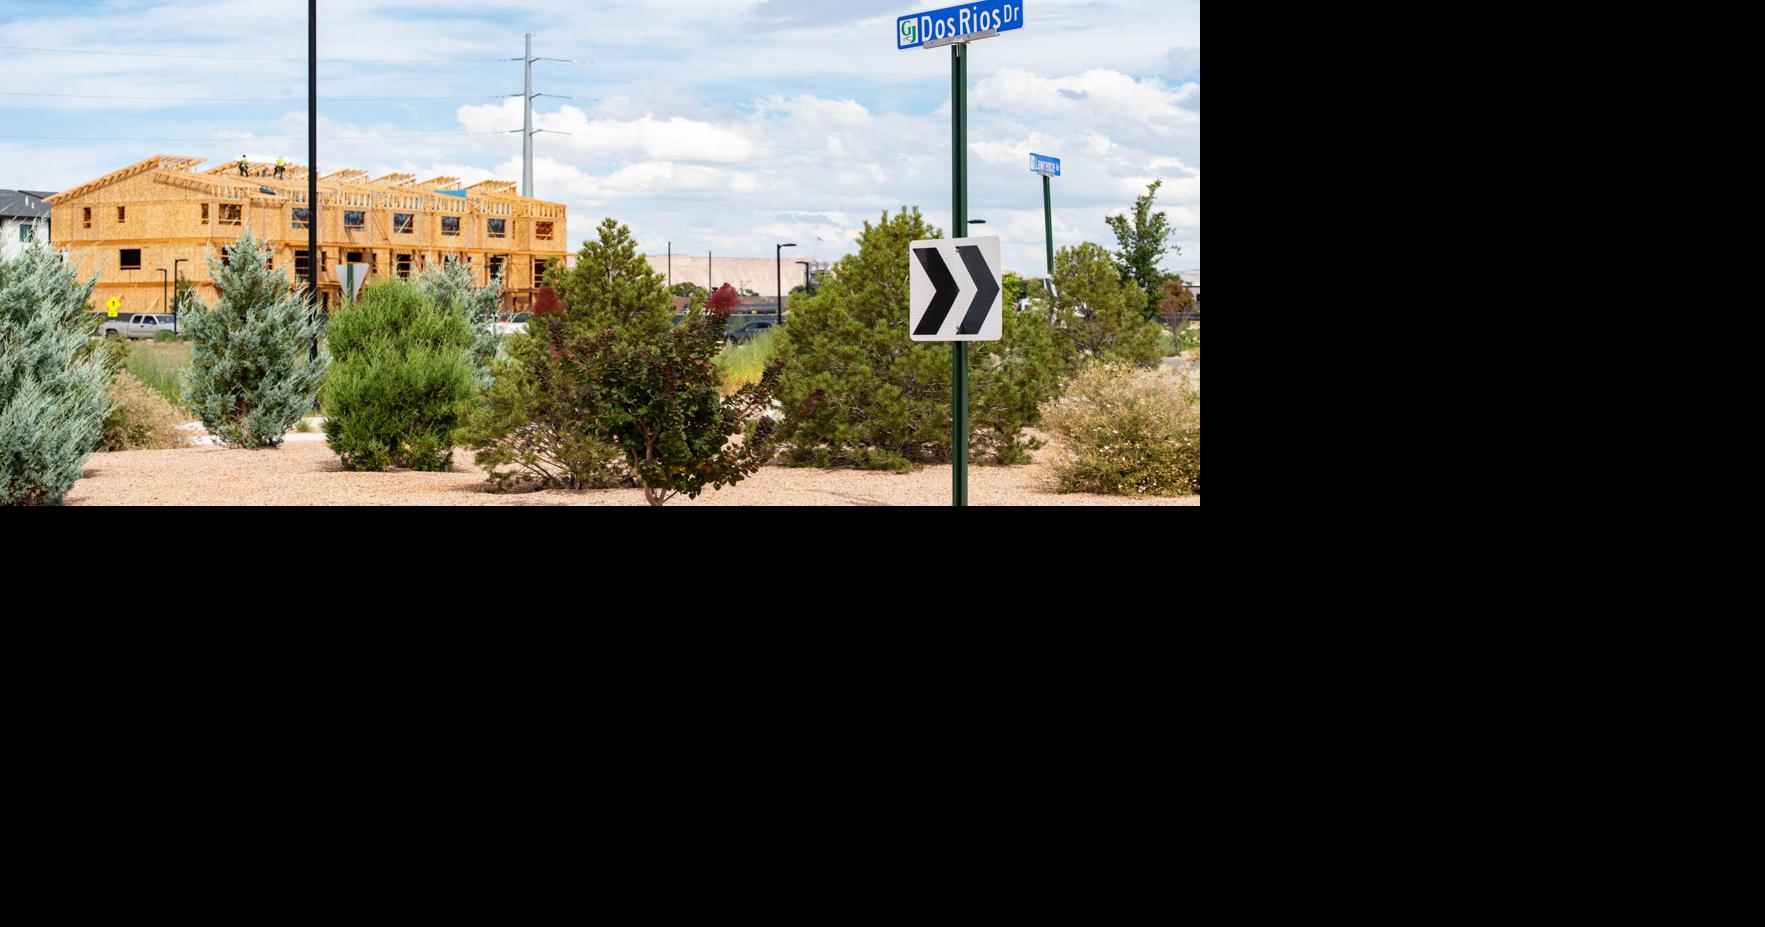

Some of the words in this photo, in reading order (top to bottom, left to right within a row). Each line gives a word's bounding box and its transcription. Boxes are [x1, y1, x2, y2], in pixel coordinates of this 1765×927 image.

[921, 15, 956, 42] Dos
[959, 5, 1002, 36] Rios
[1003, 4, 1020, 23] Dr
